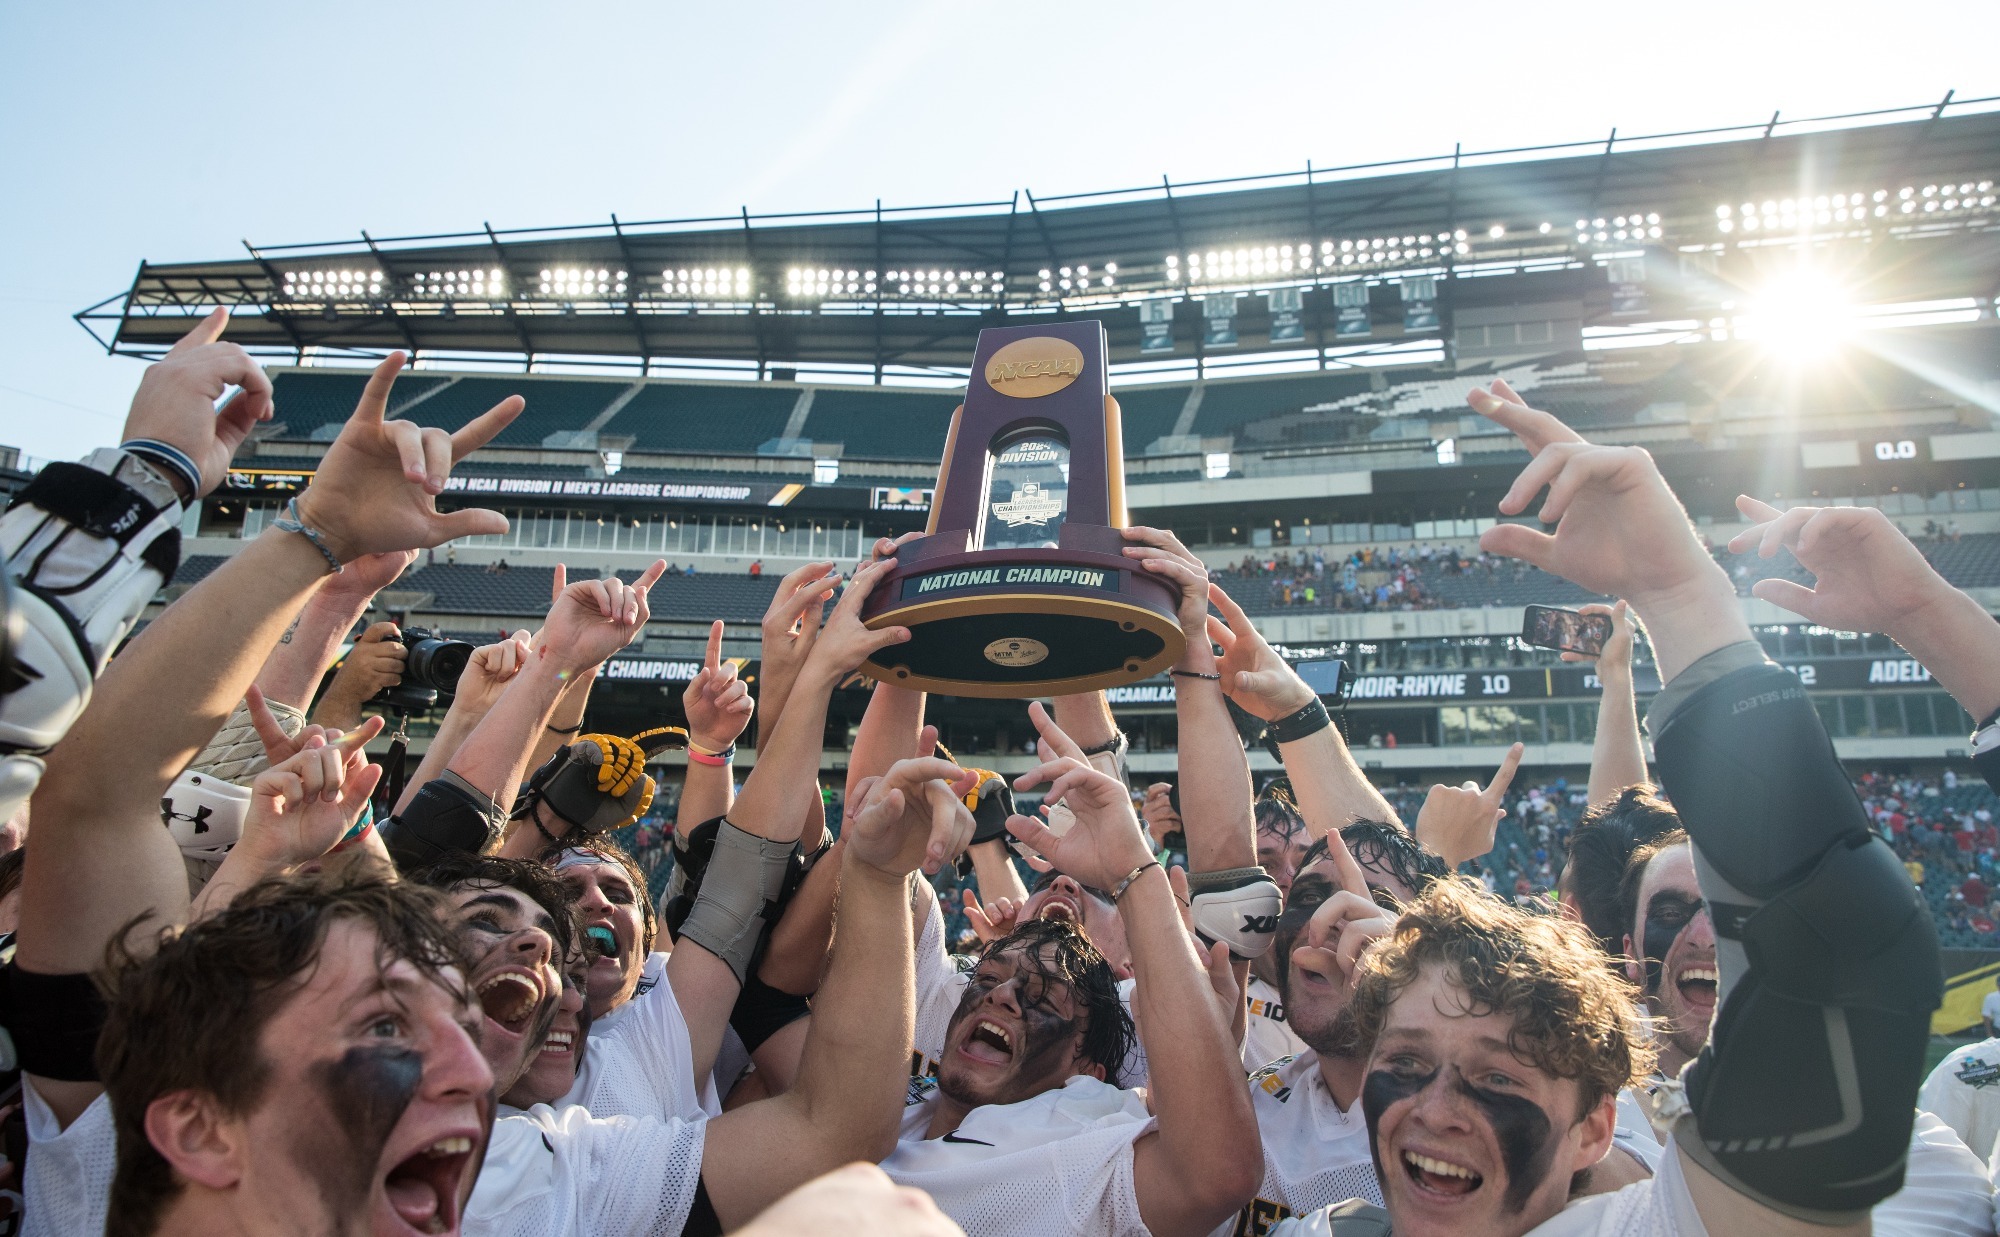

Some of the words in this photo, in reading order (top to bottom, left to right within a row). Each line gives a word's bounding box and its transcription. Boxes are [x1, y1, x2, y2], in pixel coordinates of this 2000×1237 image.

[991, 358, 1078, 384] NCAA
[1000, 451, 1058, 463] DIVISION
[1875, 441, 1917, 460] 0.0
[443, 477, 467, 490] 024
[467, 478, 499, 492] NCAA
[500, 479, 551, 493] DIVISION
[552, 481, 563, 494] II
[564, 482, 600, 495] MEN'S
[602, 483, 661, 496] LACROSSE
[662, 485, 751, 500] CHAMPIONSHIP
[997, 503, 1061, 512] CHAMPIONSHIPS
[918, 569, 1000, 593] NATIONAL
[1005, 568, 1104, 587] CHAMPION
[608, 660, 699, 681] CHAMPIONS
[1105, 686, 1177, 703] NCAAMLAX
[1343, 674, 1467, 699] ENOIR-RHYNE
[1482, 675, 1510, 694] 10
[1731, 690, 1781, 715] SELECT
